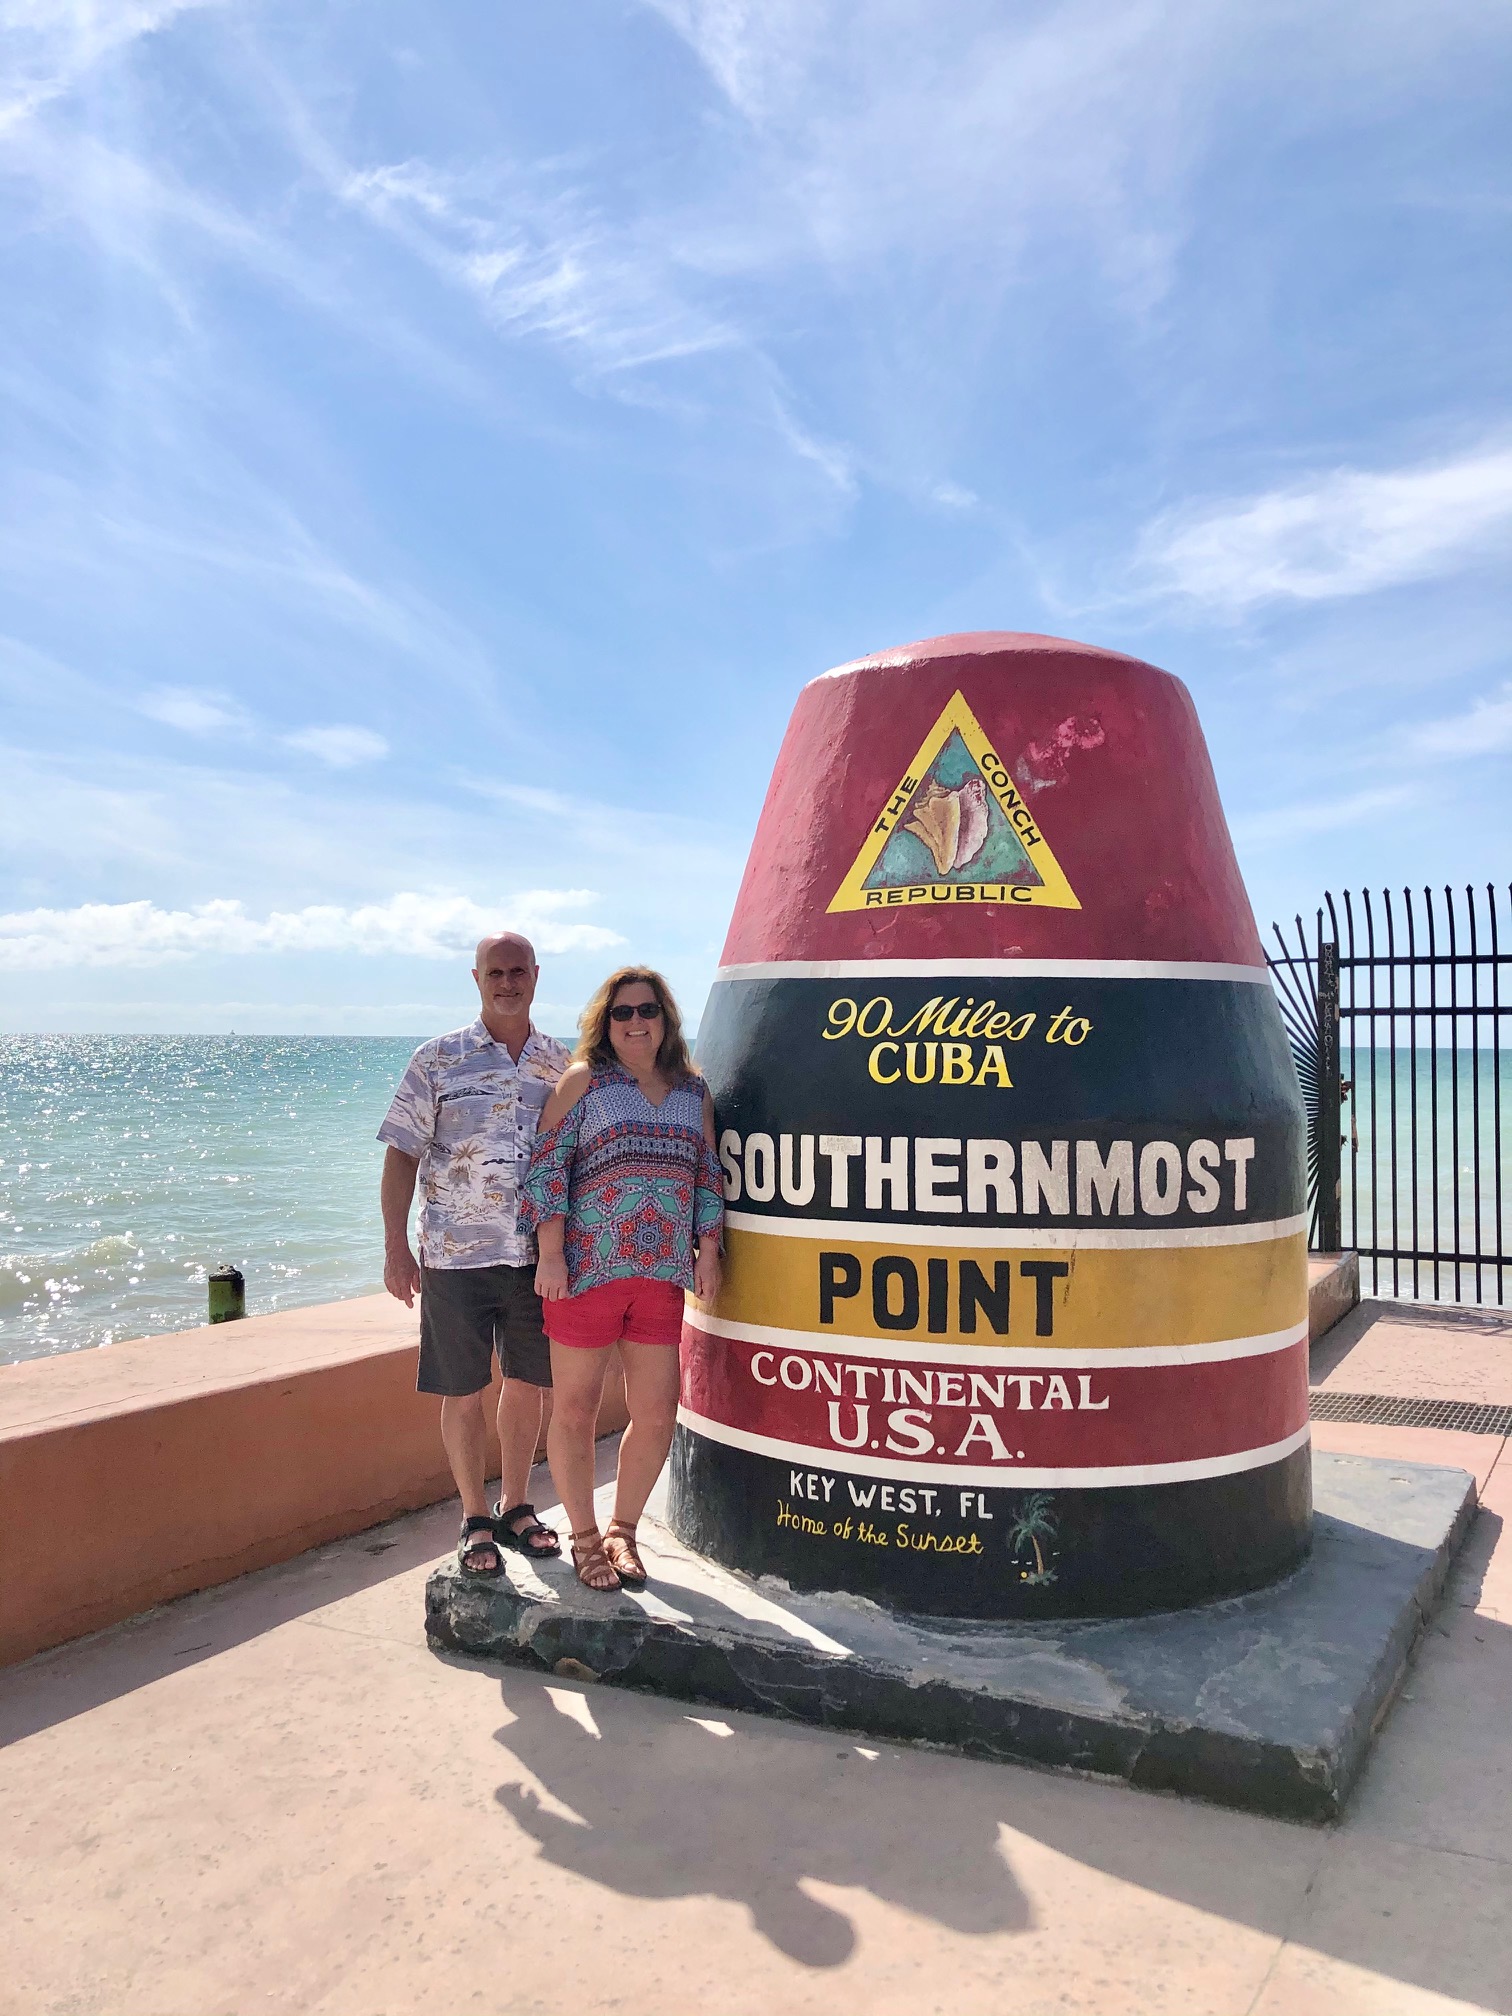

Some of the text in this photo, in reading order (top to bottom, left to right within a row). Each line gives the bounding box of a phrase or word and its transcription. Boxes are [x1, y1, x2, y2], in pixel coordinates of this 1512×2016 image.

[874, 775, 919, 834] THE
[980, 752, 1041, 847] CONCH
[865, 886, 1032, 906] REPUBLIC
[821, 996, 1094, 1046] 90 Miles to
[868, 1041, 1014, 1088] CUBA
[718, 1128, 1255, 1216] SOUTHERNMOST
[818, 1252, 1069, 1337] POINT
[750, 1351, 1110, 1410] CONTINENTAL
[827, 1400, 1026, 1460] U.S.A.
[790, 1470, 994, 1520] KEY WEST, FL
[776, 1500, 984, 1555] Home of the Sunset
